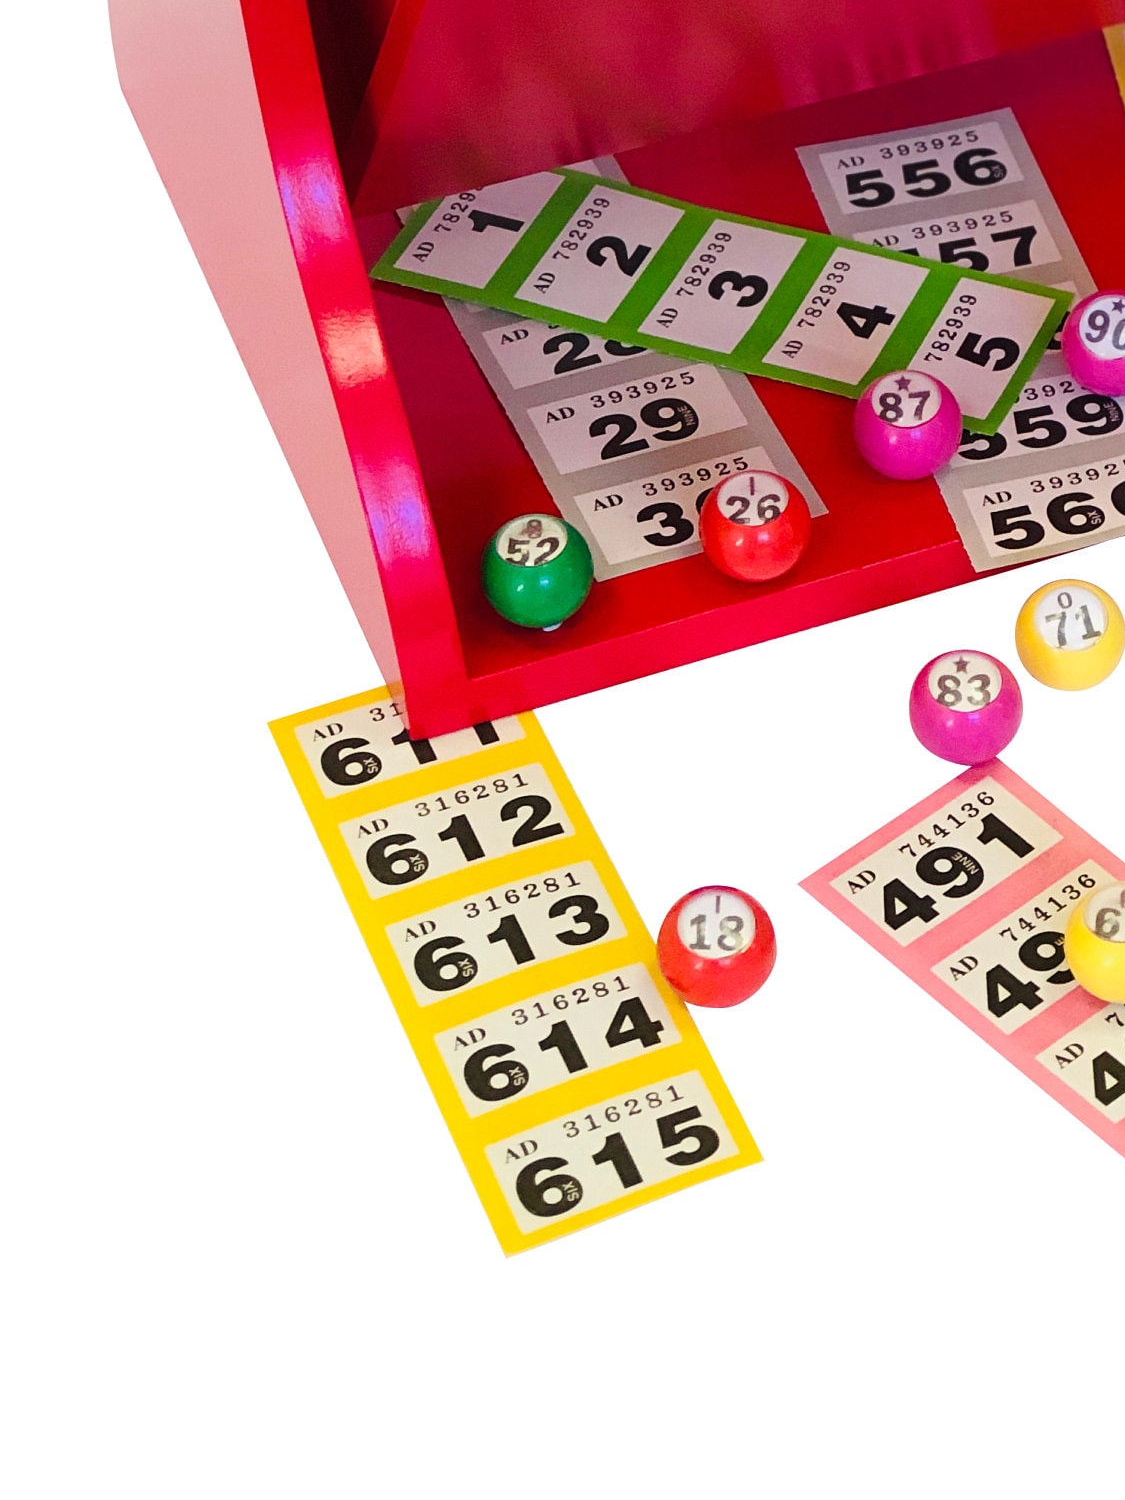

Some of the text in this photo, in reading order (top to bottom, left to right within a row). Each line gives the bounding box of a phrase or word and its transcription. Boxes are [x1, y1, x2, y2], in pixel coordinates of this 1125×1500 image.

[882, 131, 978, 159] 393925
[846, 148, 1007, 208] 556
[468, 210, 525, 232] 1
[552, 198, 609, 259] 782939
[872, 211, 1012, 246] AD 393925
[413, 242, 434, 262] AD
[586, 236, 652, 277] 2
[676, 233, 731, 296] 782939
[906, 226, 1037, 273] 57
[708, 271, 768, 307] 3
[797, 262, 850, 327] 782939
[501, 329, 528, 344] AD
[837, 302, 895, 339] 4
[924, 295, 976, 361] 782939
[955, 332, 1020, 371] 5
[590, 372, 694, 408] 393925
[879, 391, 931, 423] 87
[589, 398, 699, 460] 29
[642, 451, 748, 496] 393925
[725, 493, 782, 524] 26
[505, 536, 560, 566] 52
[1045, 604, 1102, 649] 71
[936, 672, 992, 708] 83
[312, 723, 343, 742] AD
[415, 774, 528, 816] 316281
[366, 795, 564, 885] 612
[898, 792, 994, 860] 744136
[883, 813, 1035, 930] 491
[464, 872, 580, 918] 316281
[414, 895, 609, 991] 613
[688, 913, 746, 952] 18
[950, 874, 1095, 981] AD 744136
[512, 976, 629, 1025] 316281
[464, 997, 664, 1101] 614
[504, 1086, 683, 1162] AD 316281
[516, 1105, 719, 1217] 615
